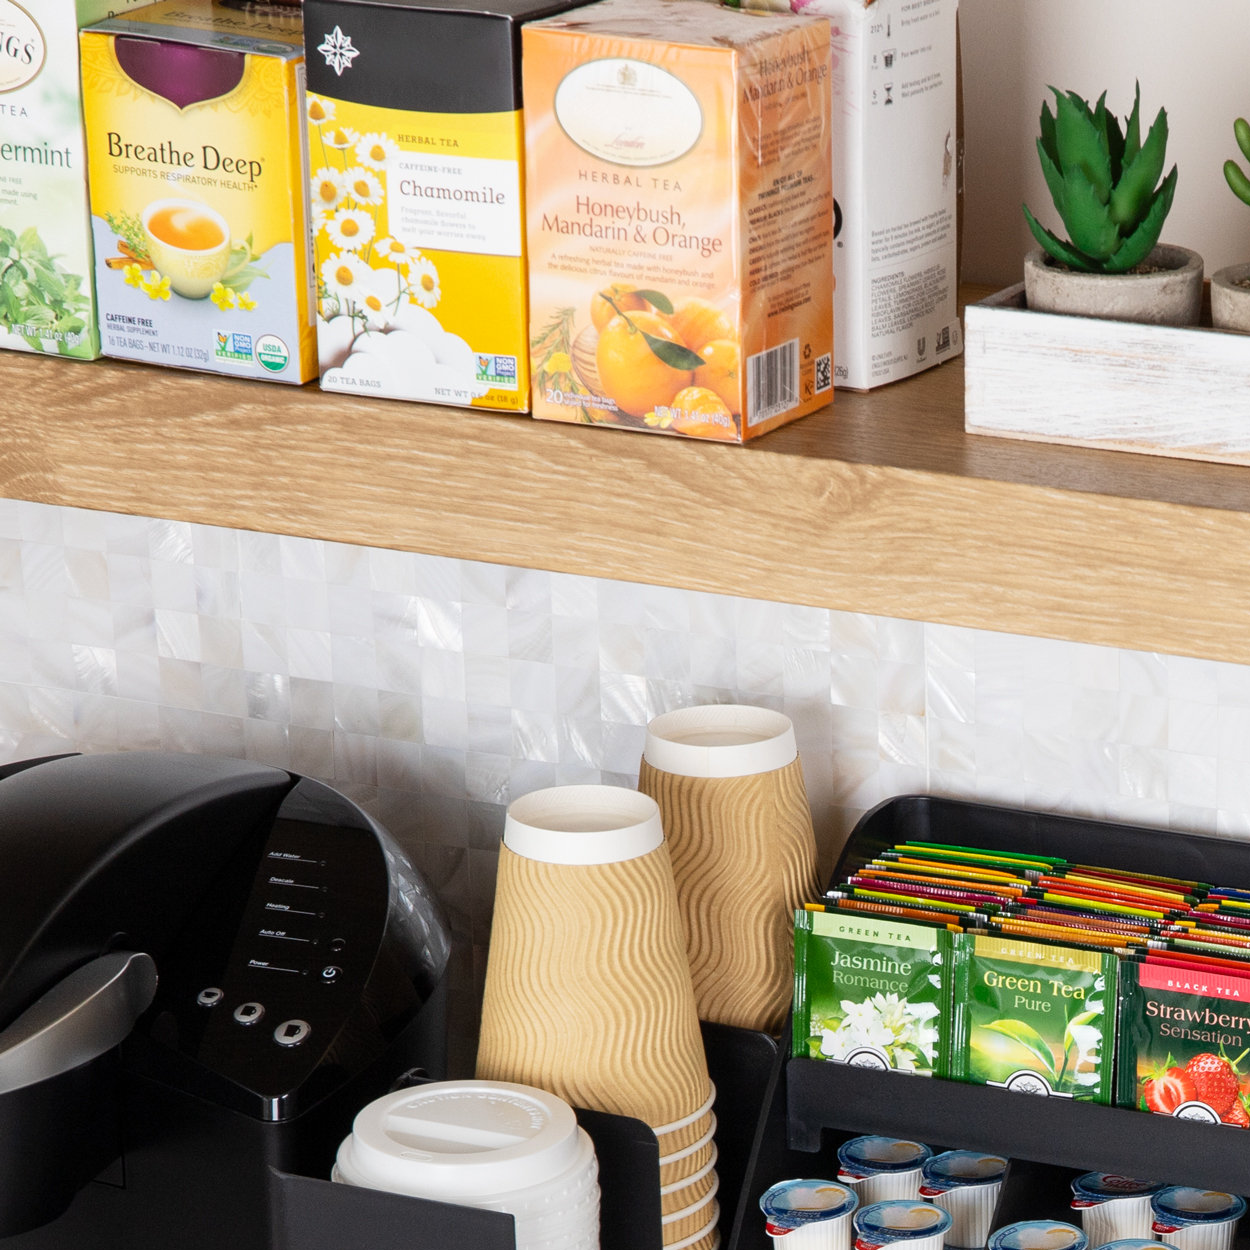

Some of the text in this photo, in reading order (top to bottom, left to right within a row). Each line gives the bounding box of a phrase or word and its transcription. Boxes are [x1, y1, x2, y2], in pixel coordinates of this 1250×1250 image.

[107, 132, 195, 168] Breathe
[397, 134, 460, 148] HERBAL TEA
[112, 164, 217, 187] SUPPORTS RESPIRATORY
[578, 169, 682, 192] HERBAL TEA
[400, 179, 505, 205] Chamomile
[575, 194, 686, 229] Honeybush,
[541, 213, 722, 258] Mandarin & Orange
[106, 313, 153, 328] CAFFEINE FREE
[116, 336, 128, 347] TEA
[129, 339, 144, 350] BAGS
[148, 341, 159, 352] NET
[160, 343, 171, 354] WT
[262, 343, 281, 353] USDA
[496, 357, 515, 365] NON
[496, 364, 515, 372] GMO
[327, 375, 381, 389] 20 TEA BAGS
[434, 387, 453, 397] NET
[455, 389, 469, 398] WT
[485, 393, 495, 401] oz
[545, 388, 563, 404] 20
[654, 405, 669, 418] NET
[670, 407, 682, 419] WT
[702, 414, 710, 423] oz
[266, 902, 291, 910] Heating
[838, 925, 912, 942] GREEN TEA
[831, 951, 912, 976] Jasmine
[1000, 947, 1075, 964] GREEN TEA
[831, 970, 909, 993] Romance
[983, 969, 1086, 1000] Green Tea
[1167, 980, 1240, 997] BLACK TEA
[1013, 995, 1052, 1013] Pure
[1159, 1022, 1243, 1047] Sensation
